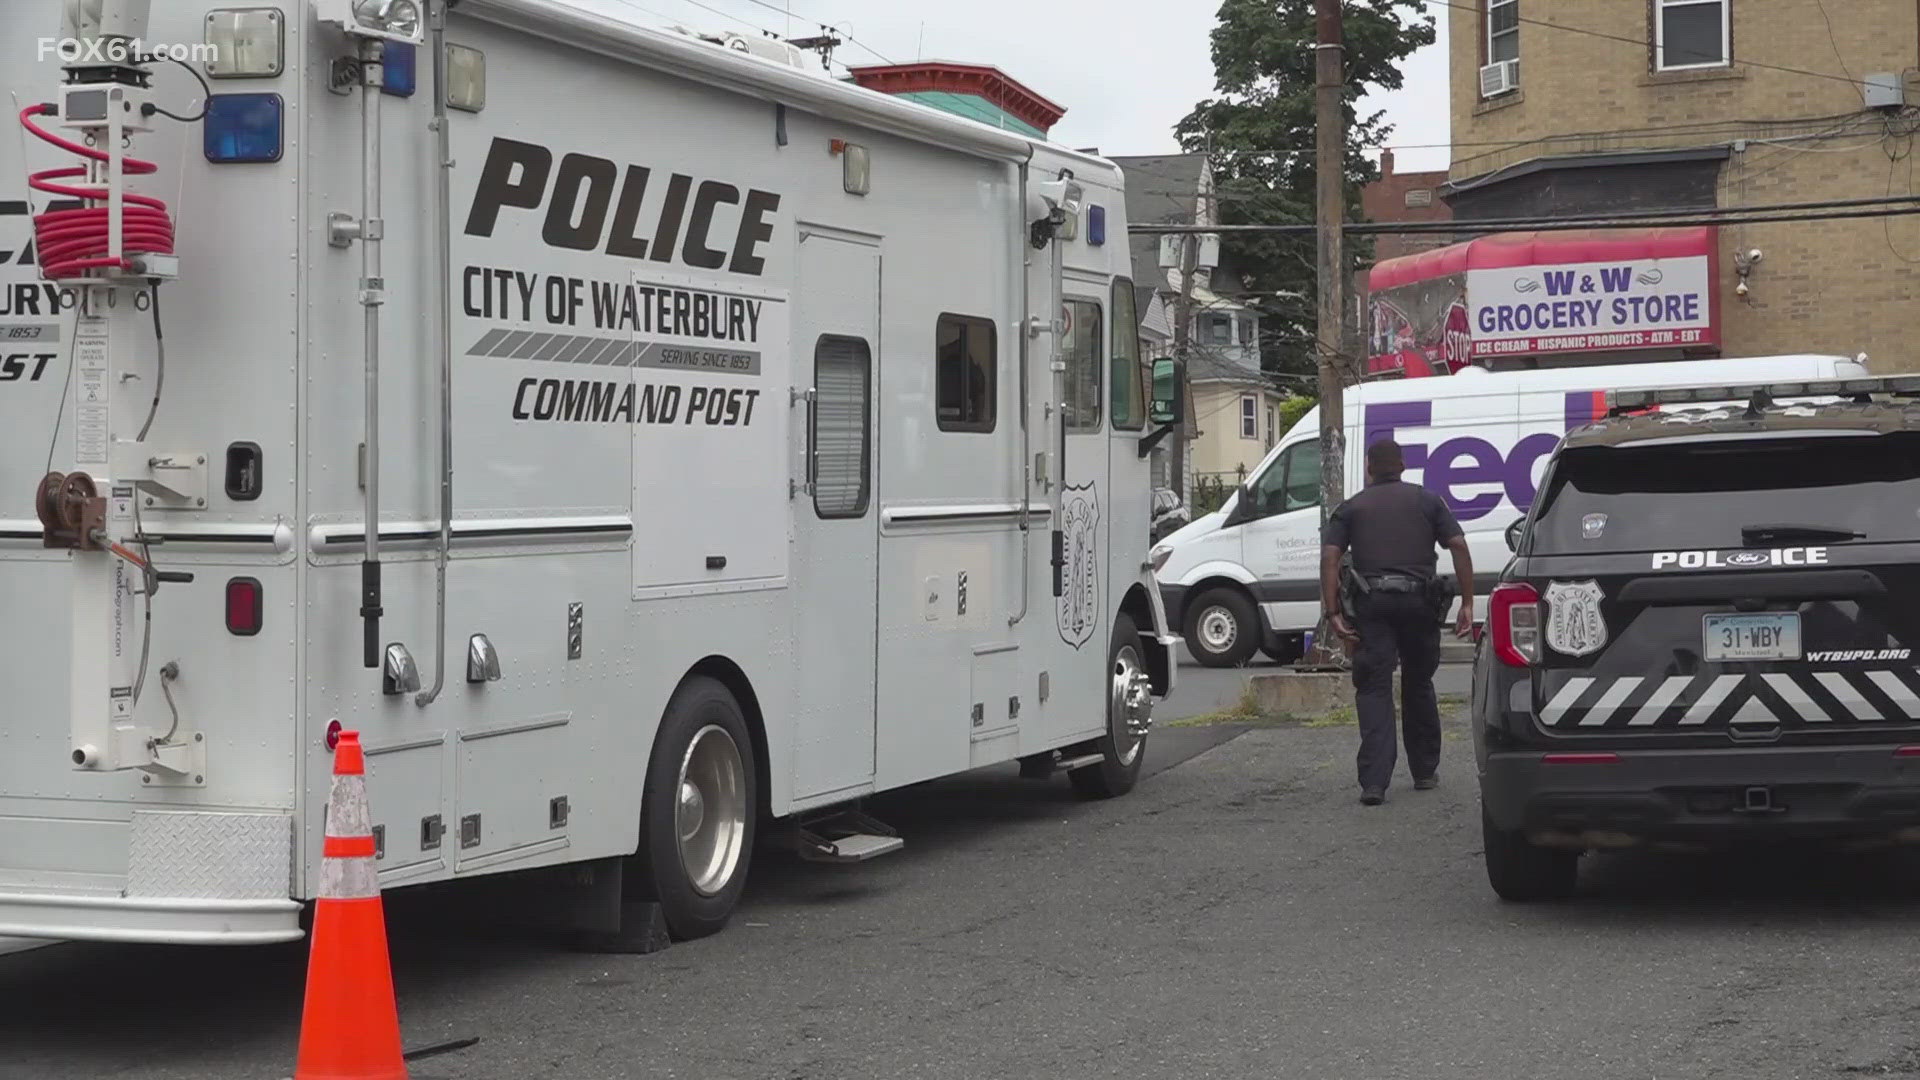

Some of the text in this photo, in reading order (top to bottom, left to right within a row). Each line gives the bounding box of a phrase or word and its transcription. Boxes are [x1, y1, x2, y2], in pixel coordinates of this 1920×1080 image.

[464, 136, 781, 276] POLICE
[1543, 267, 1632, 296] W & W
[463, 266, 762, 343] CITY OF WATERBURY
[1478, 293, 1699, 333] GROCERY STORE
[8, 327, 42, 338] 1853
[1447, 330, 1471, 364] STOP
[1475, 342, 1492, 354] ICE
[1494, 340, 1529, 353] CREAM
[1537, 337, 1586, 350] HISPANIC
[1587, 334, 1643, 348] PRODUCTS
[1651, 331, 1673, 344] ATM
[1681, 330, 1701, 342] EBT
[0, 353, 57, 381] ST
[660, 349, 751, 370] SERVING SINCE 1853
[512, 378, 760, 426] COMMAND POST
[1364, 390, 1608, 522] Fed
[1807, 649, 1911, 662] WTBYPD.ORG
